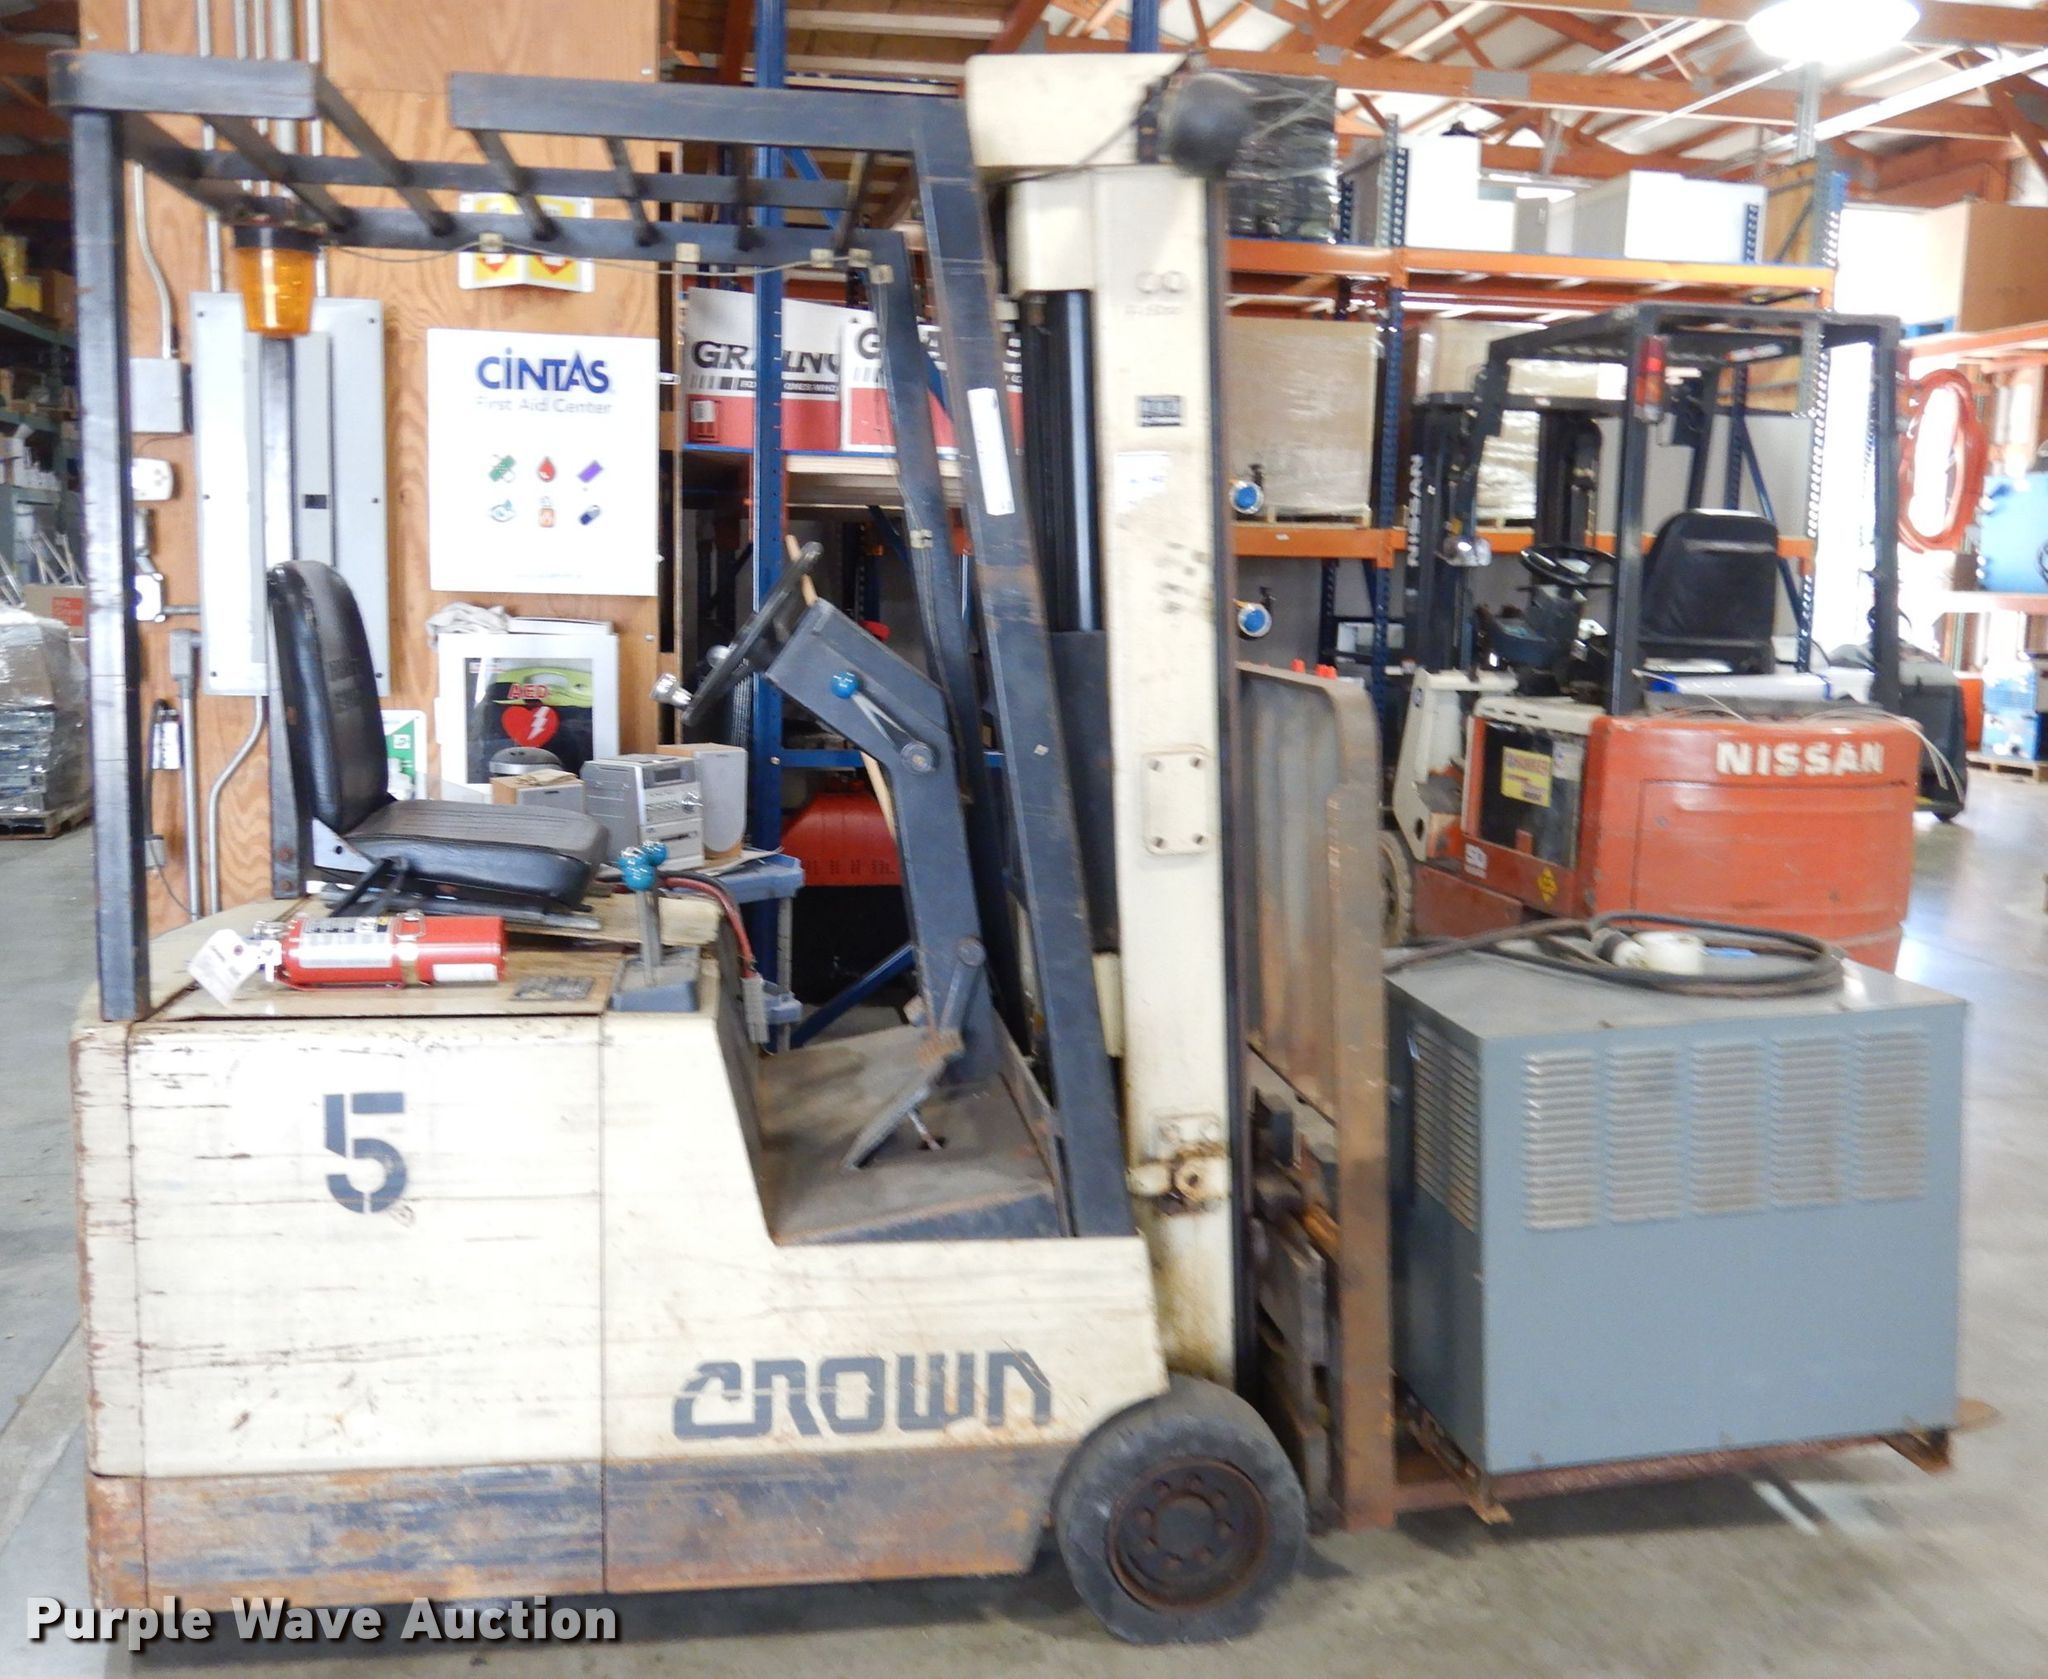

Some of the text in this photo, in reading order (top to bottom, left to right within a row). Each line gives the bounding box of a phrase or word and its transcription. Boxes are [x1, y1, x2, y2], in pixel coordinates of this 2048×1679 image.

[519, 397, 549, 412] Aid
[552, 398, 612, 415] Center
[507, 683, 552, 700] AED
[1716, 741, 1885, 776] NISSAN
[323, 1092, 408, 1214] 5
[673, 1350, 1051, 1439] CROWN
